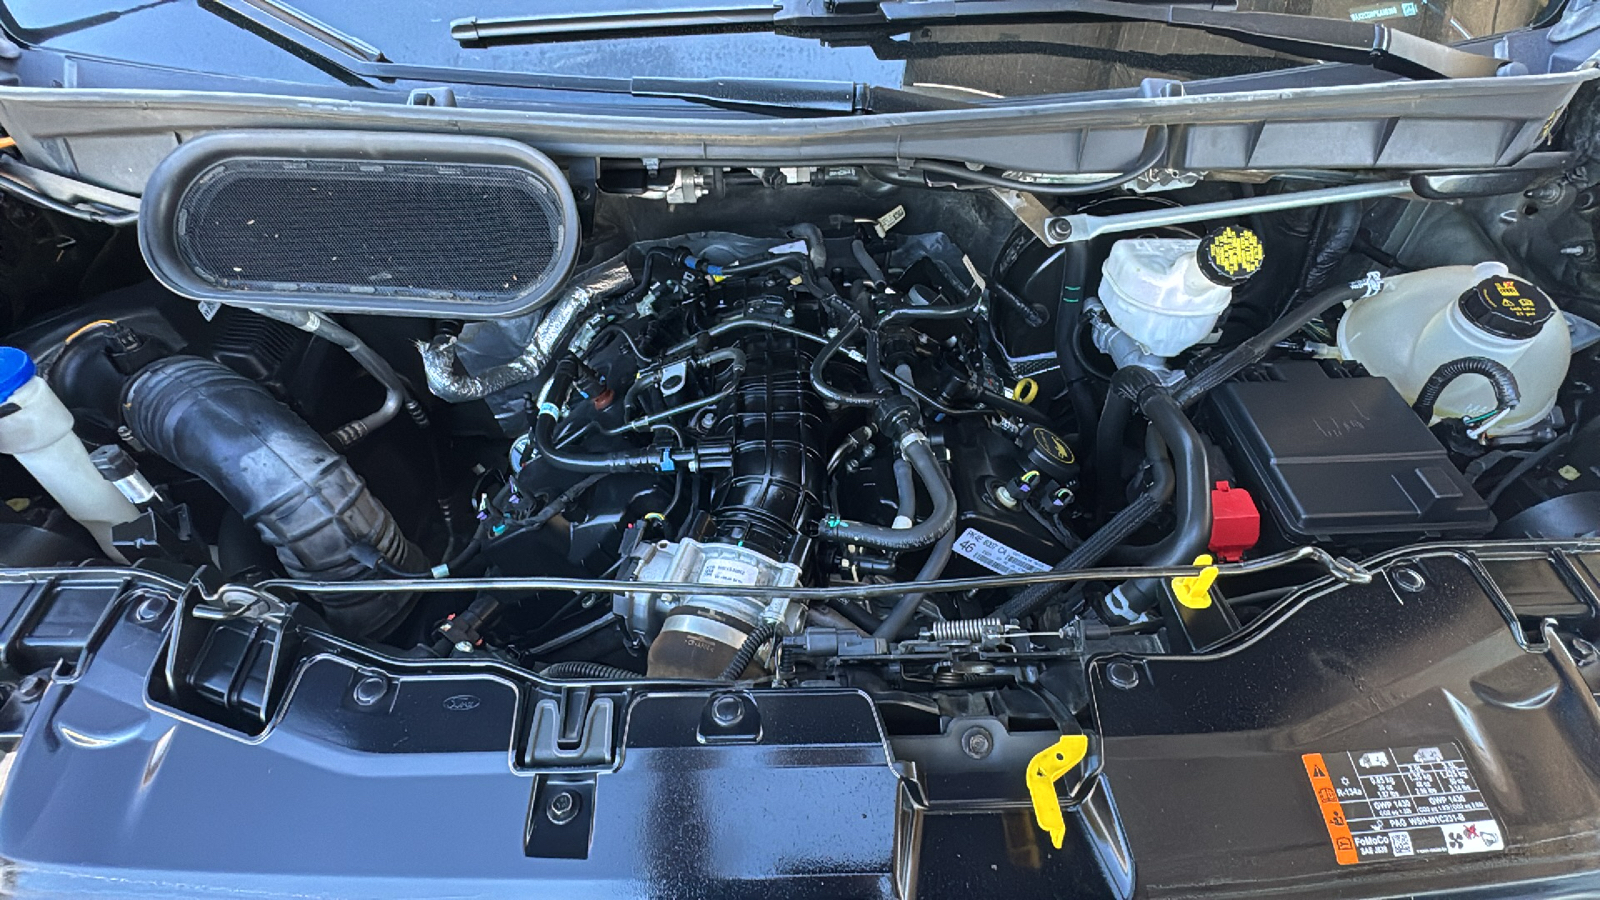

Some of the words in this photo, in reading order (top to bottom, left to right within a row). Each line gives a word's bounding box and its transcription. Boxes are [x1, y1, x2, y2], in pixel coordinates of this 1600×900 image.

[960, 540, 976, 553] 46
[1336, 787, 1363, 797] R-134a
[1373, 801, 1392, 810] GWP
[1393, 800, 1411, 808] 1430
[1428, 796, 1447, 805] GWP
[1448, 795, 1466, 803] 1430
[1389, 818, 1407, 827] PAG
[1354, 835, 1389, 847] FoMoCo
